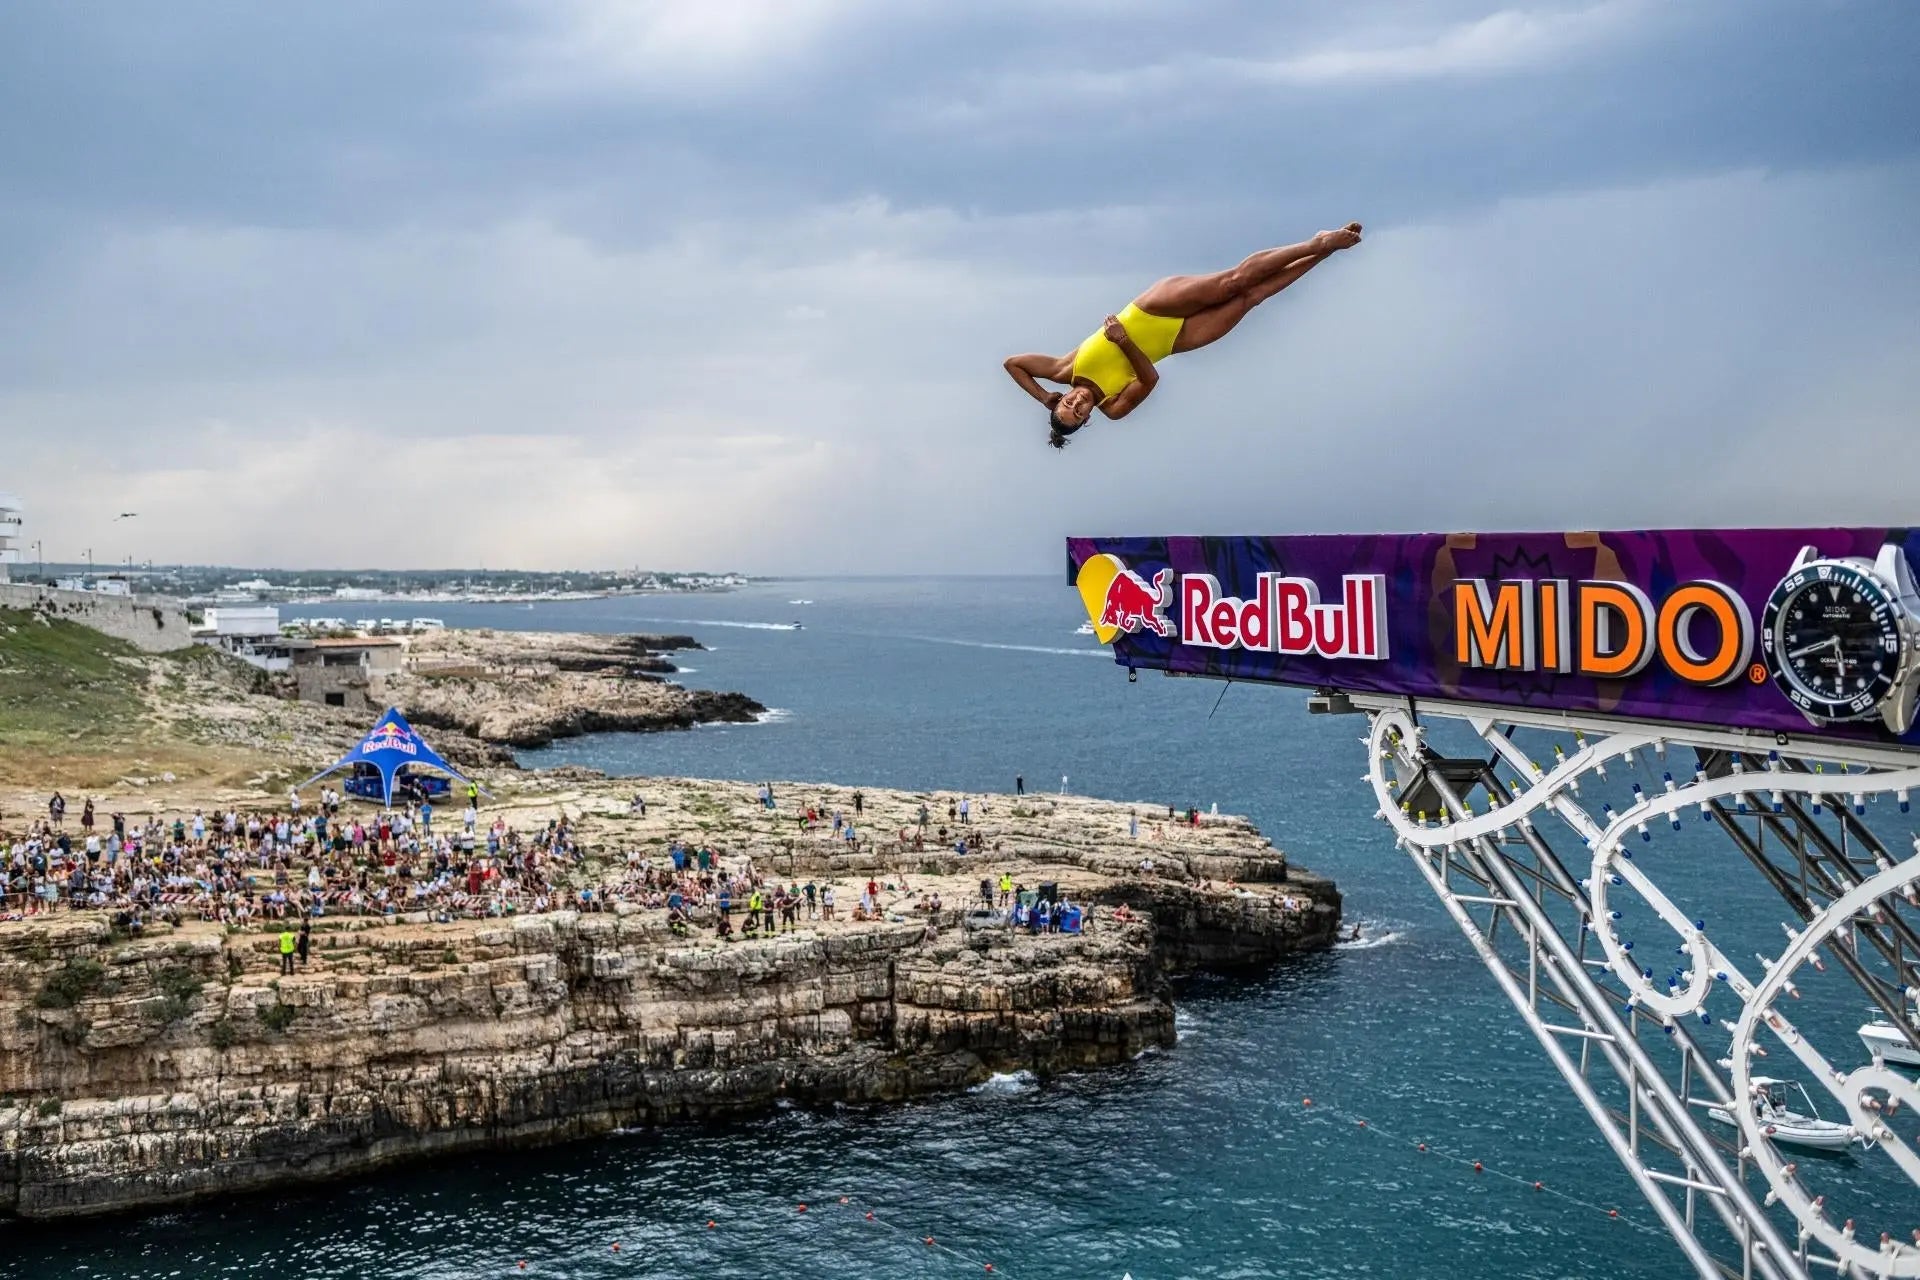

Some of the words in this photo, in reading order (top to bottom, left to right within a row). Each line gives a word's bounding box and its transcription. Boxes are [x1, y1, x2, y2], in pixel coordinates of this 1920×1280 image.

[1784, 573, 1805, 592] 55
[1453, 581, 1744, 685] MIDO
[1764, 627, 1773, 654] 45
[1885, 633, 1897, 654] 15
[1789, 690, 1812, 709] 35
[1850, 692, 1874, 712] 25
